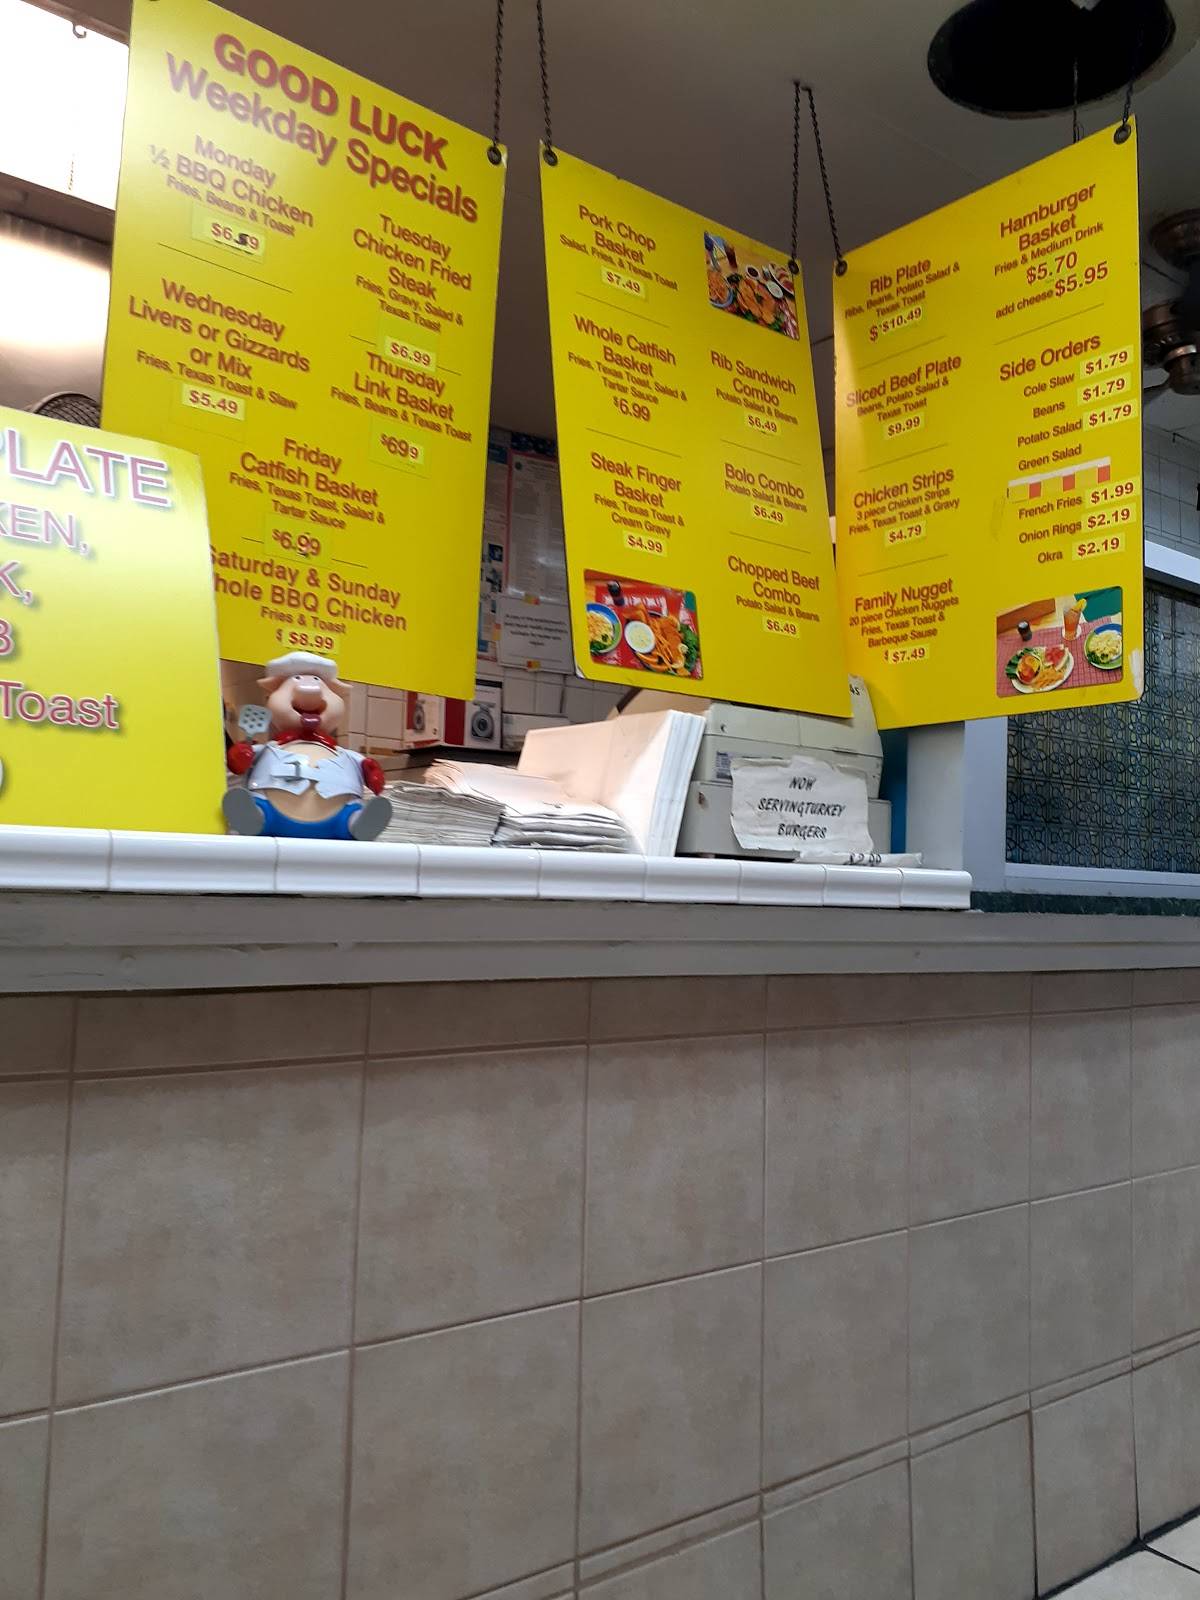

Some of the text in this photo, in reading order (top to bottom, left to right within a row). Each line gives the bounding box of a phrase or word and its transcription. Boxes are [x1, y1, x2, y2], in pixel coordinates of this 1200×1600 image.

[214, 33, 448, 170] GOOD LUCK
[166, 51, 478, 223] Weekday Specials
[195, 135, 276, 188] Monday
[176, 153, 226, 192] BBQ
[232, 178, 313, 228] Chicken
[206, 191, 246, 216] Beans
[249, 209, 258, 222] &
[262, 211, 295, 236] Toast
[578, 204, 656, 252] Pork Chop
[1000, 183, 1096, 238] Hamburger
[380, 214, 451, 262] Tuesday
[595, 230, 645, 265] Basket
[994, 222, 1104, 276] Fries & Medium Drink
[1018, 213, 1076, 251] Basket
[353, 228, 472, 291] Chicken Fried
[870, 259, 931, 296] Rib Plate
[1026, 251, 1078, 285] $5.70
[388, 266, 436, 300] Steak
[607, 271, 640, 293] $7.49
[995, 261, 1108, 319] add cheese $5.95
[162, 278, 285, 342] Wednesday
[129, 295, 311, 372] Livers or Gizzards
[573, 314, 676, 366] Whole Catfish
[190, 348, 253, 379] or Mix
[390, 342, 431, 366] $6.99
[603, 345, 654, 377] Basket
[1000, 335, 1101, 381] Side Orders
[176, 362, 215, 385] Texas
[219, 374, 253, 397] Toast
[256, 387, 265, 400] &
[268, 390, 298, 409] Slaw
[366, 351, 445, 398] Thursday
[710, 351, 796, 394] Rib Sandwich
[846, 356, 961, 407] Sliced Beef Plate
[1023, 351, 1128, 397] Cole Slaw $1.79
[189, 389, 238, 414] $5.49
[354, 372, 454, 422] Link Basket
[613, 396, 650, 422] $6.99
[732, 377, 780, 406] Combo
[1032, 378, 1125, 418] Beans $1.79
[401, 410, 409, 422] &
[412, 413, 442, 433] Texas
[748, 415, 777, 433] $6.49
[887, 416, 920, 436] $9.99
[1017, 404, 1132, 447] Potato Salad $1.79
[0, 427, 170, 505] LATE
[283, 438, 342, 474] Friday
[591, 451, 633, 479] Steak
[637, 464, 681, 492] Finger
[1018, 444, 1082, 471] Green Salad
[240, 452, 378, 507] Catfish Basket
[614, 480, 664, 508] Basket
[725, 462, 804, 499] Bolo Combo
[854, 469, 954, 508] Chicken Strips
[266, 481, 301, 501] Texas
[376, 512, 385, 525] &
[754, 505, 784, 523] $6.49
[864, 505, 886, 519] piece
[888, 495, 922, 511] Chicken
[924, 488, 950, 502] Strips
[872, 516, 896, 529] Texas
[898, 507, 922, 521] Toast
[924, 505, 931, 515] &
[933, 498, 960, 512] Gravy
[1018, 482, 1134, 519] French Fries $1.99
[309, 509, 346, 529] Sauce
[889, 525, 922, 543] $4.79
[1018, 508, 1130, 544] Onion Rings $2.19
[627, 535, 662, 553] $4.99
[1037, 537, 1120, 564] Okra $2.19
[306, 567, 320, 588] &
[328, 572, 400, 609] Sunday
[728, 555, 819, 591] Chopped Beef
[271, 584, 319, 613] BBQ
[326, 597, 407, 631] Chicken
[753, 581, 800, 605] Combo
[855, 578, 953, 612] Family Nugget
[885, 604, 919, 618] Chicken
[921, 596, 959, 612] Nuggets
[260, 606, 346, 634] Fries & Toast
[766, 619, 796, 635] $6.49
[885, 620, 910, 631] Texas
[911, 614, 936, 626] Toast
[938, 611, 945, 621] &
[289, 631, 334, 649] $8.99
[868, 633, 908, 648] Barbeque
[892, 647, 925, 663] $7.49
[0, 680, 119, 729] Toast
[789, 776, 818, 791] NOW
[777, 823, 828, 840] BURGERS
